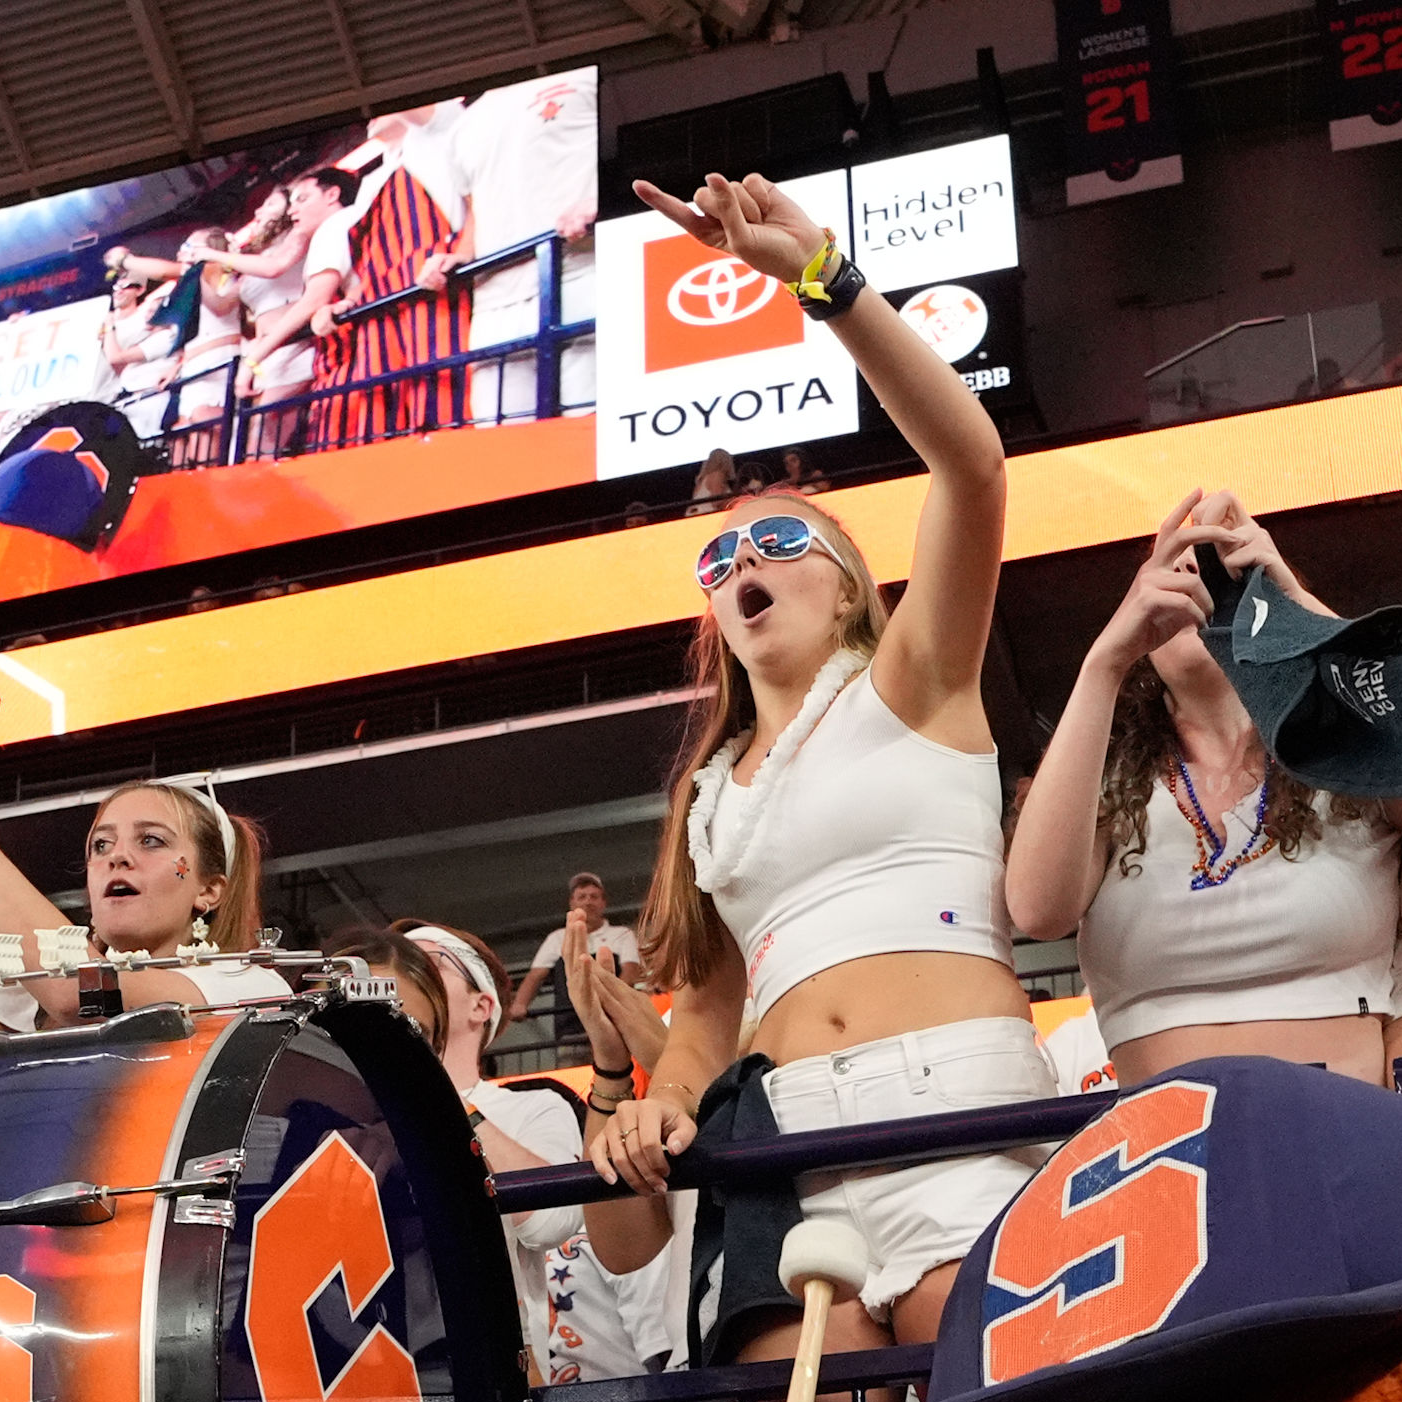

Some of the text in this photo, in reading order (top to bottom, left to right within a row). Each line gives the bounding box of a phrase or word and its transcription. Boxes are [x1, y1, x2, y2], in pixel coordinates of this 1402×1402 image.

[1078, 35, 1150, 61] LACROSSE
[1081, 61, 1150, 86] ROWAN
[1085, 80, 1150, 134] 21
[863, 181, 1004, 225] Hidden
[864, 209, 964, 252] Level
[618, 377, 834, 443] TOYOTA
[1368, 660, 1396, 712] CHEV
[982, 1080, 1218, 1388] S
